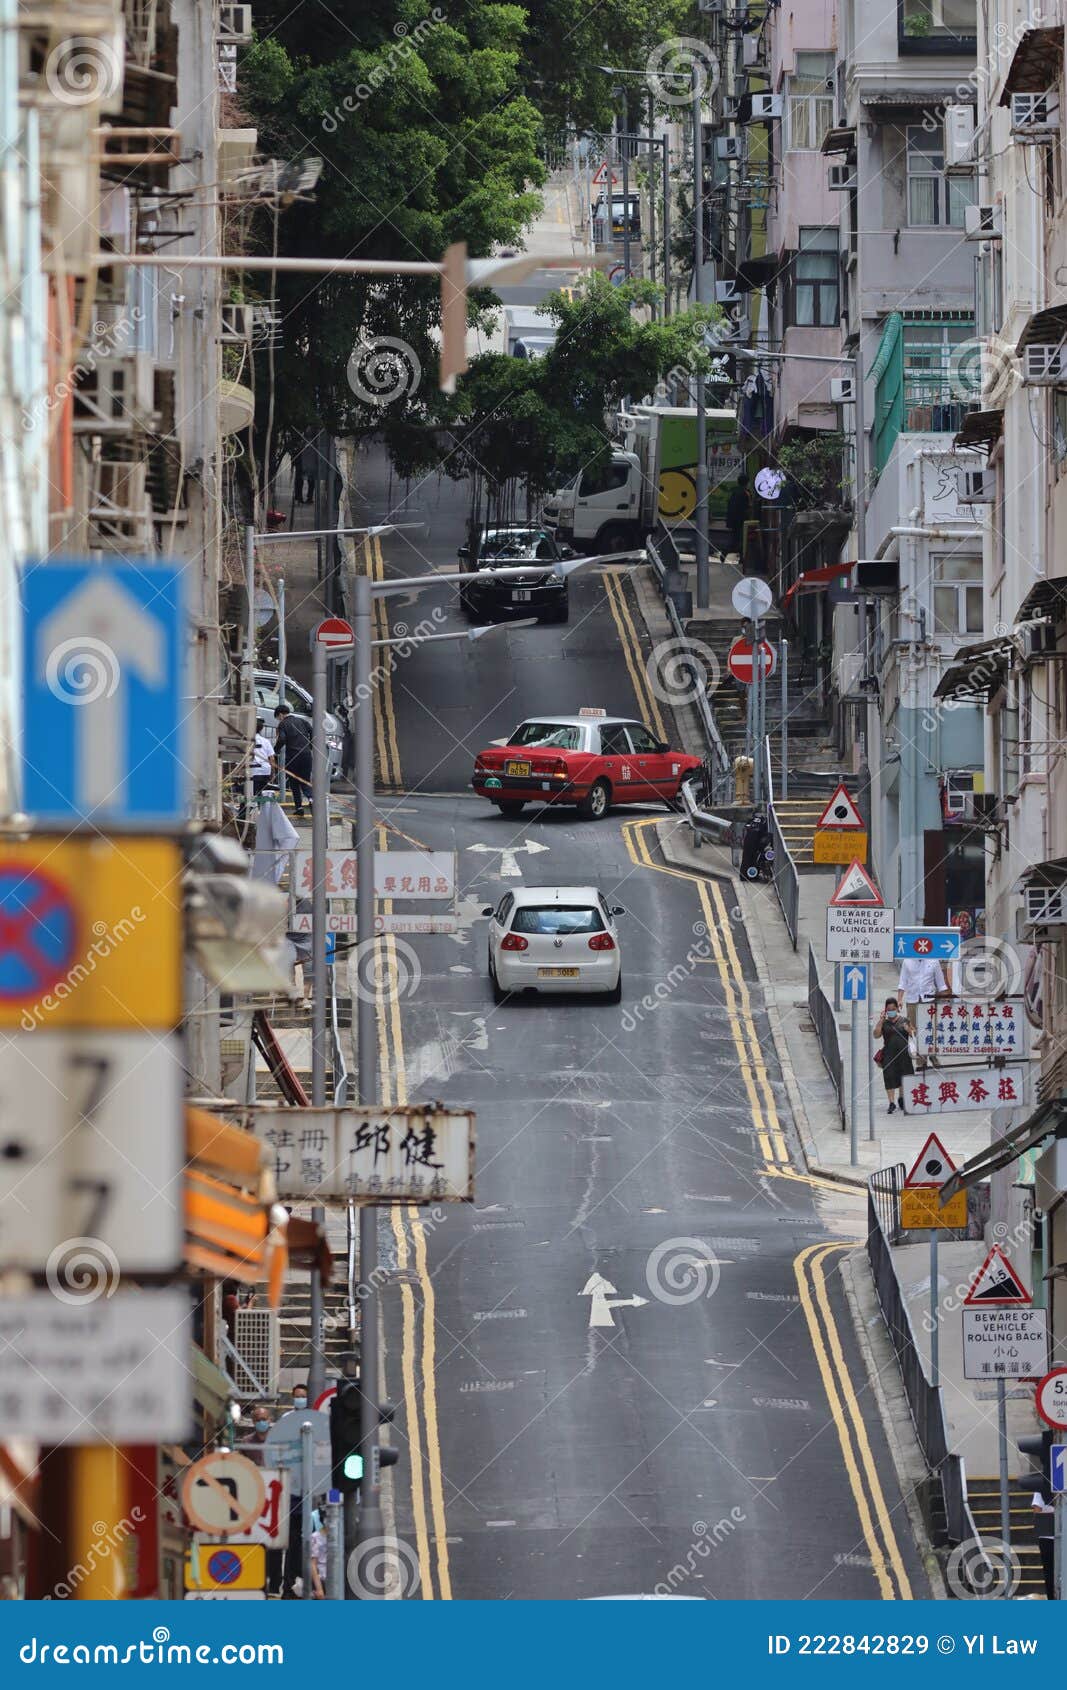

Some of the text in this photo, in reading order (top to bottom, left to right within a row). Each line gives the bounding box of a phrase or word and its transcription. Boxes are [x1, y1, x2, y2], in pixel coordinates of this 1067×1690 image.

[868, 926, 891, 934] BACK
[849, 937, 870, 946] 小心
[911, 1077, 1018, 1107] 建興茶莊
[349, 1121, 445, 1169] 邱健
[974, 1312, 1035, 1322] BEWARE OF
[983, 1323, 1027, 1332] VEHICLE
[967, 1332, 1043, 1342] ROLLING BACK
[993, 1345, 1019, 1357] 小心
